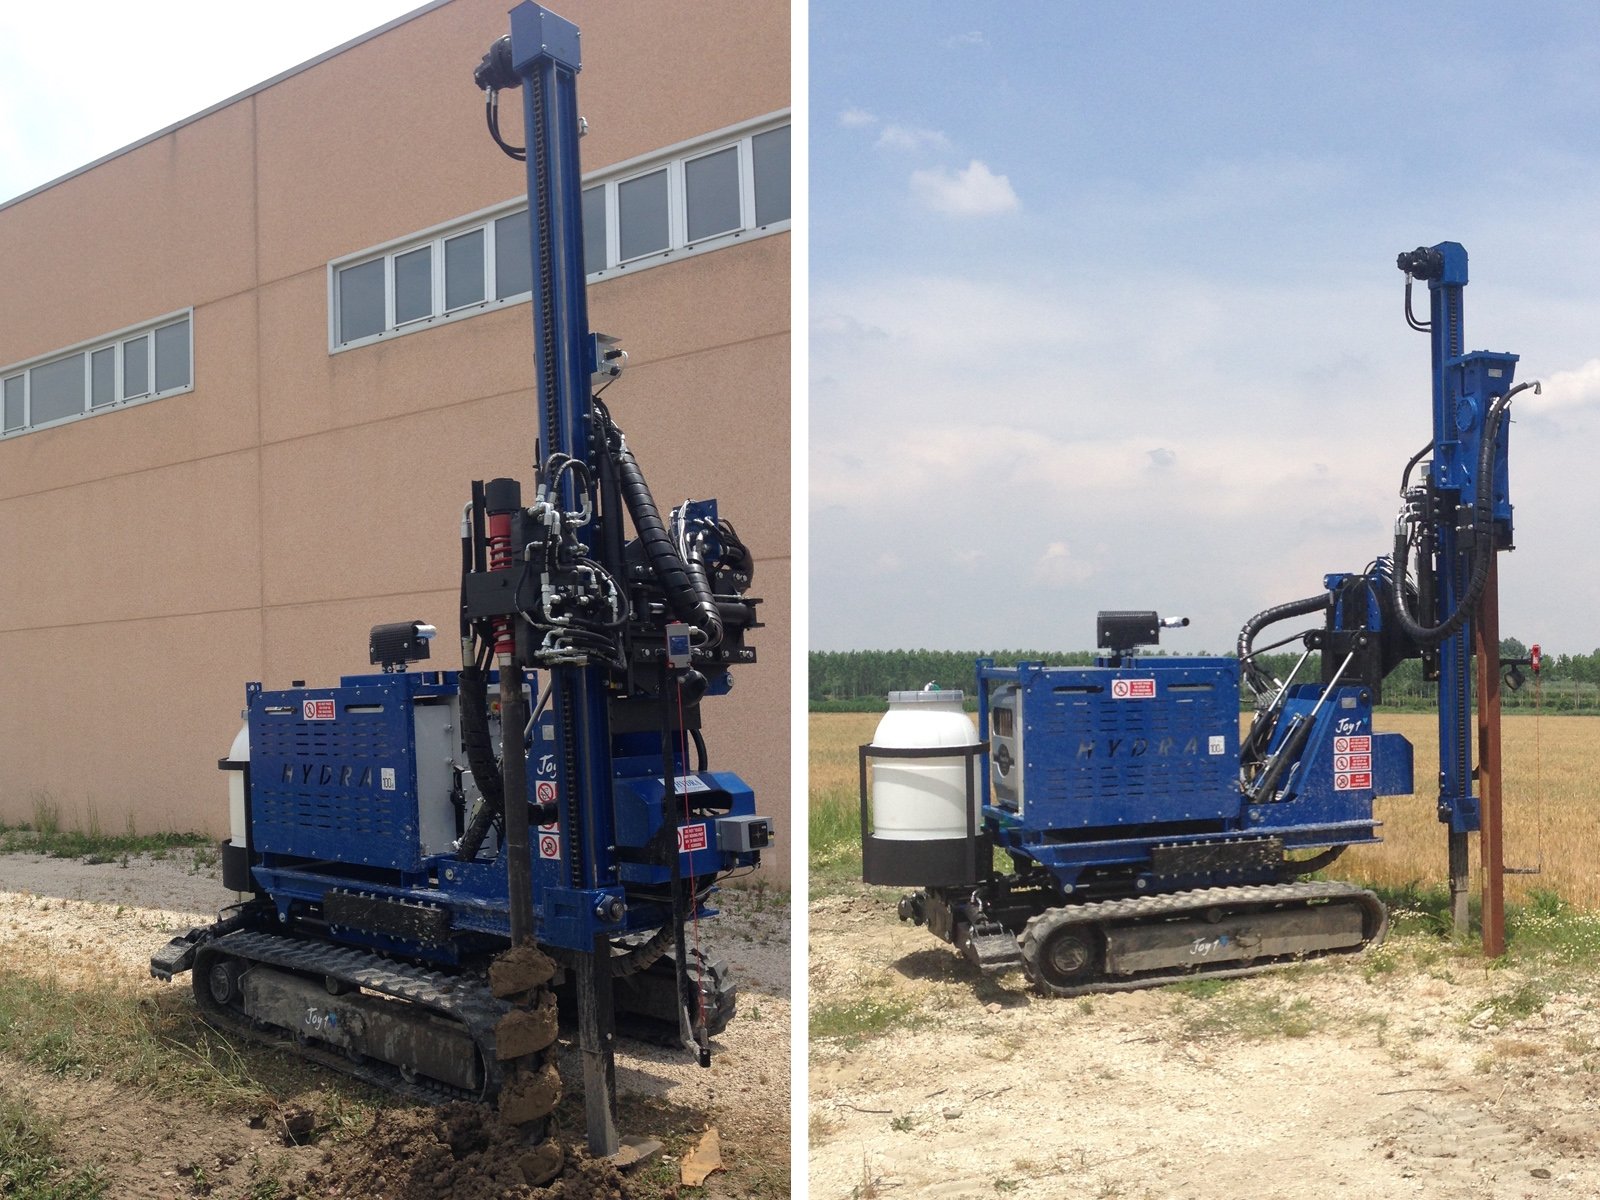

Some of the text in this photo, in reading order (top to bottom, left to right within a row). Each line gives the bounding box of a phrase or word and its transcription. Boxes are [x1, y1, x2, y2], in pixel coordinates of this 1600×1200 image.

[1335, 717, 1362, 735] Joy1
[1077, 736, 1199, 759] HYDRA
[282, 763, 373, 787] HYDRA
[1189, 937, 1220, 957] Joy1
